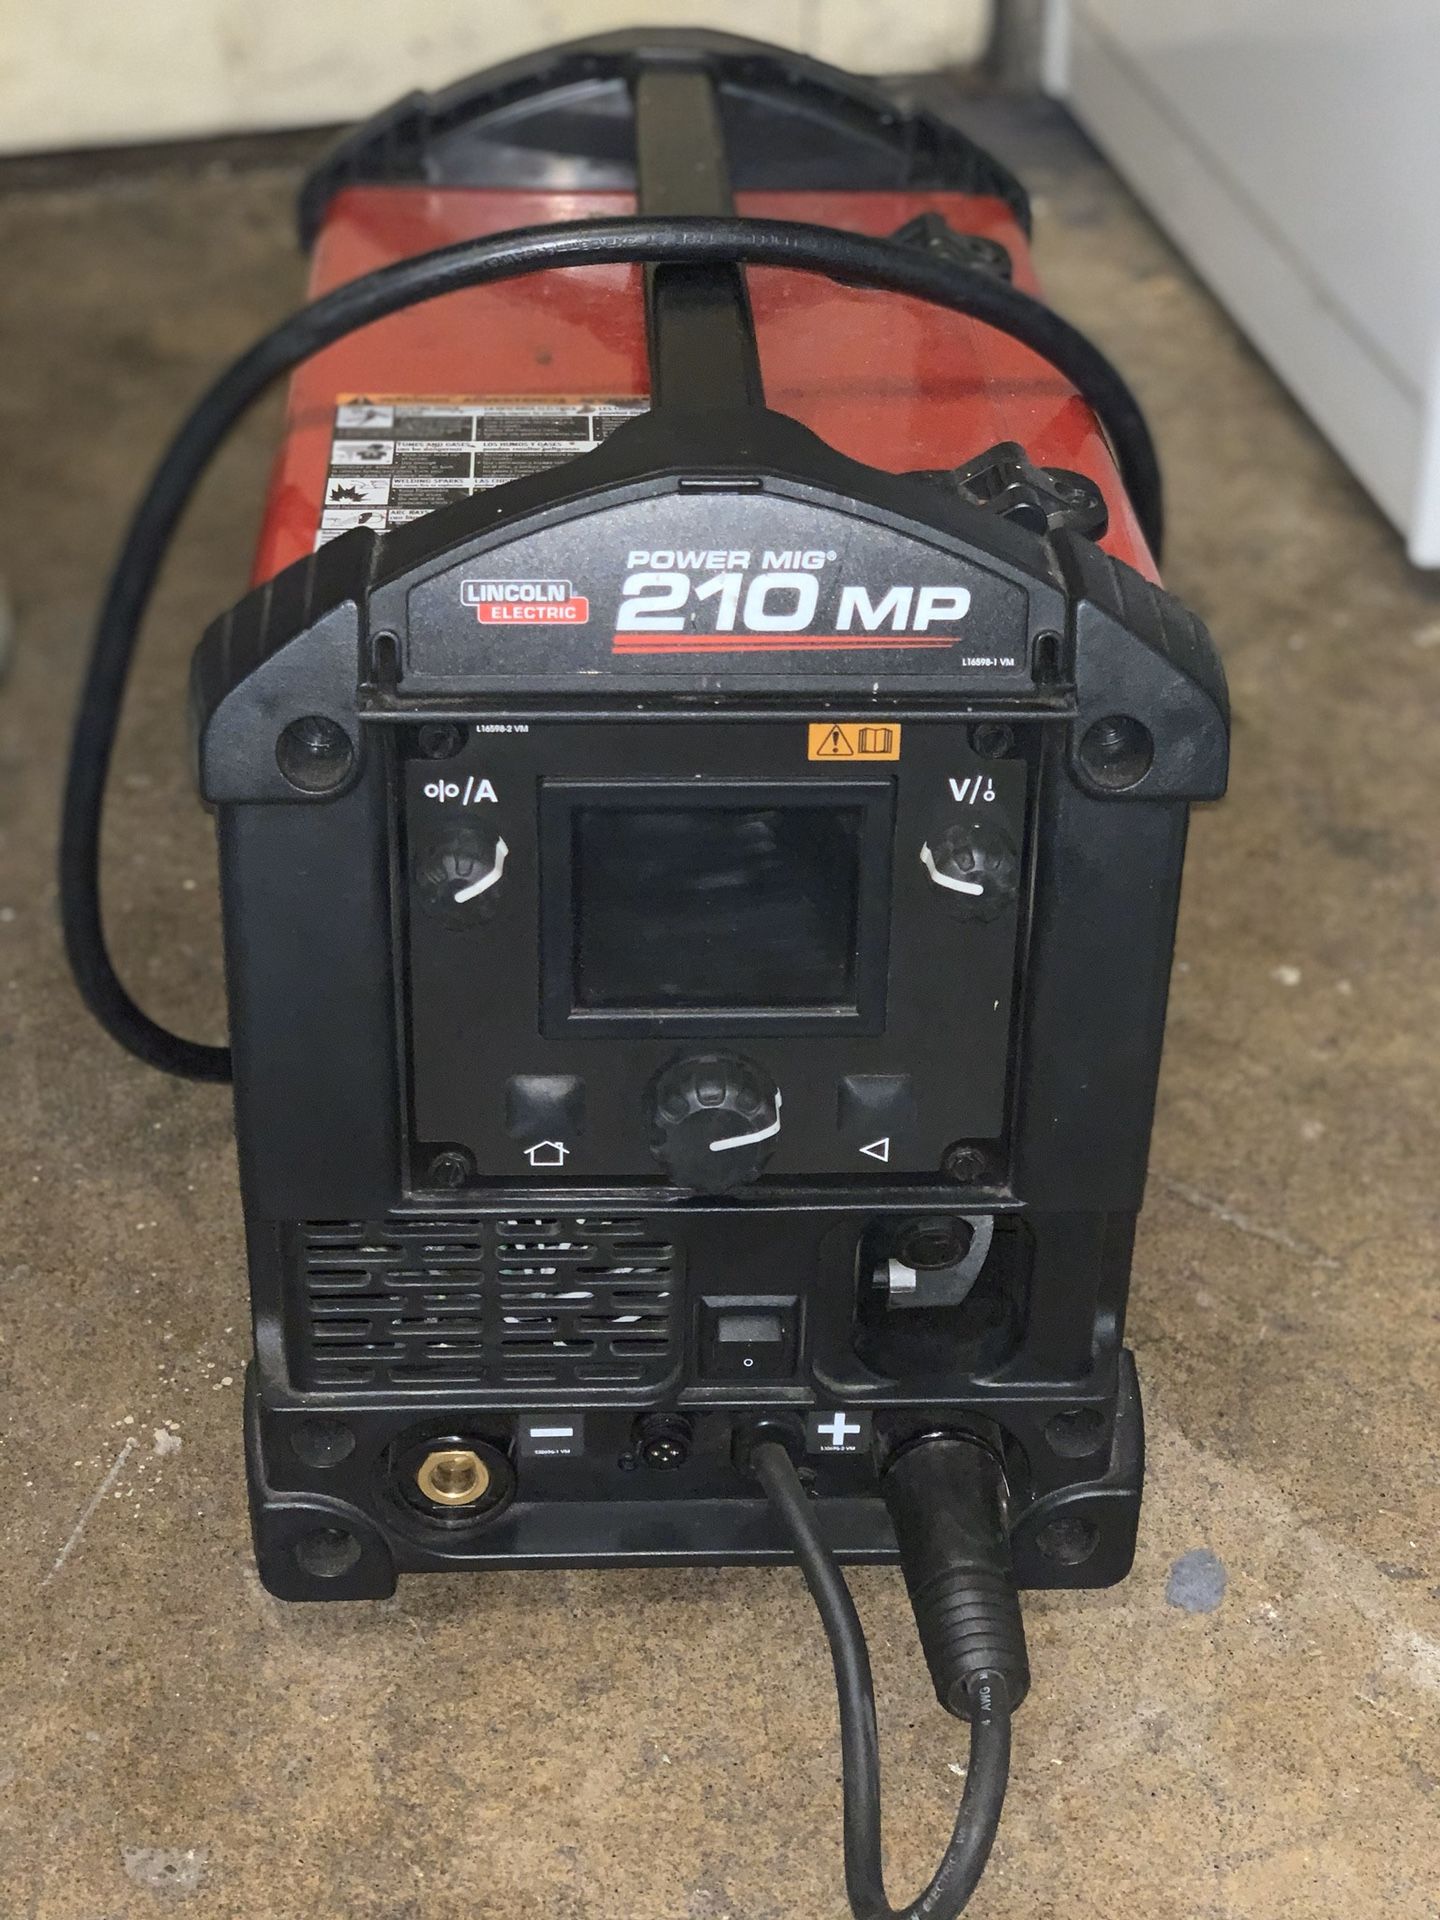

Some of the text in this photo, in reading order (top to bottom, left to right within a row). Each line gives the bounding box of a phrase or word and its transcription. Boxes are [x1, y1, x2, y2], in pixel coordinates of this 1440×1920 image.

[627, 550, 750, 569] POWER
[467, 584, 566, 602] LINCOLN
[615, 571, 972, 632] 210 MP
[490, 606, 577, 620] ELECTRIC
[1000, 657, 1015, 667] VM
[513, 724, 529, 733] VM
[979, 1686, 992, 1711] AWG
